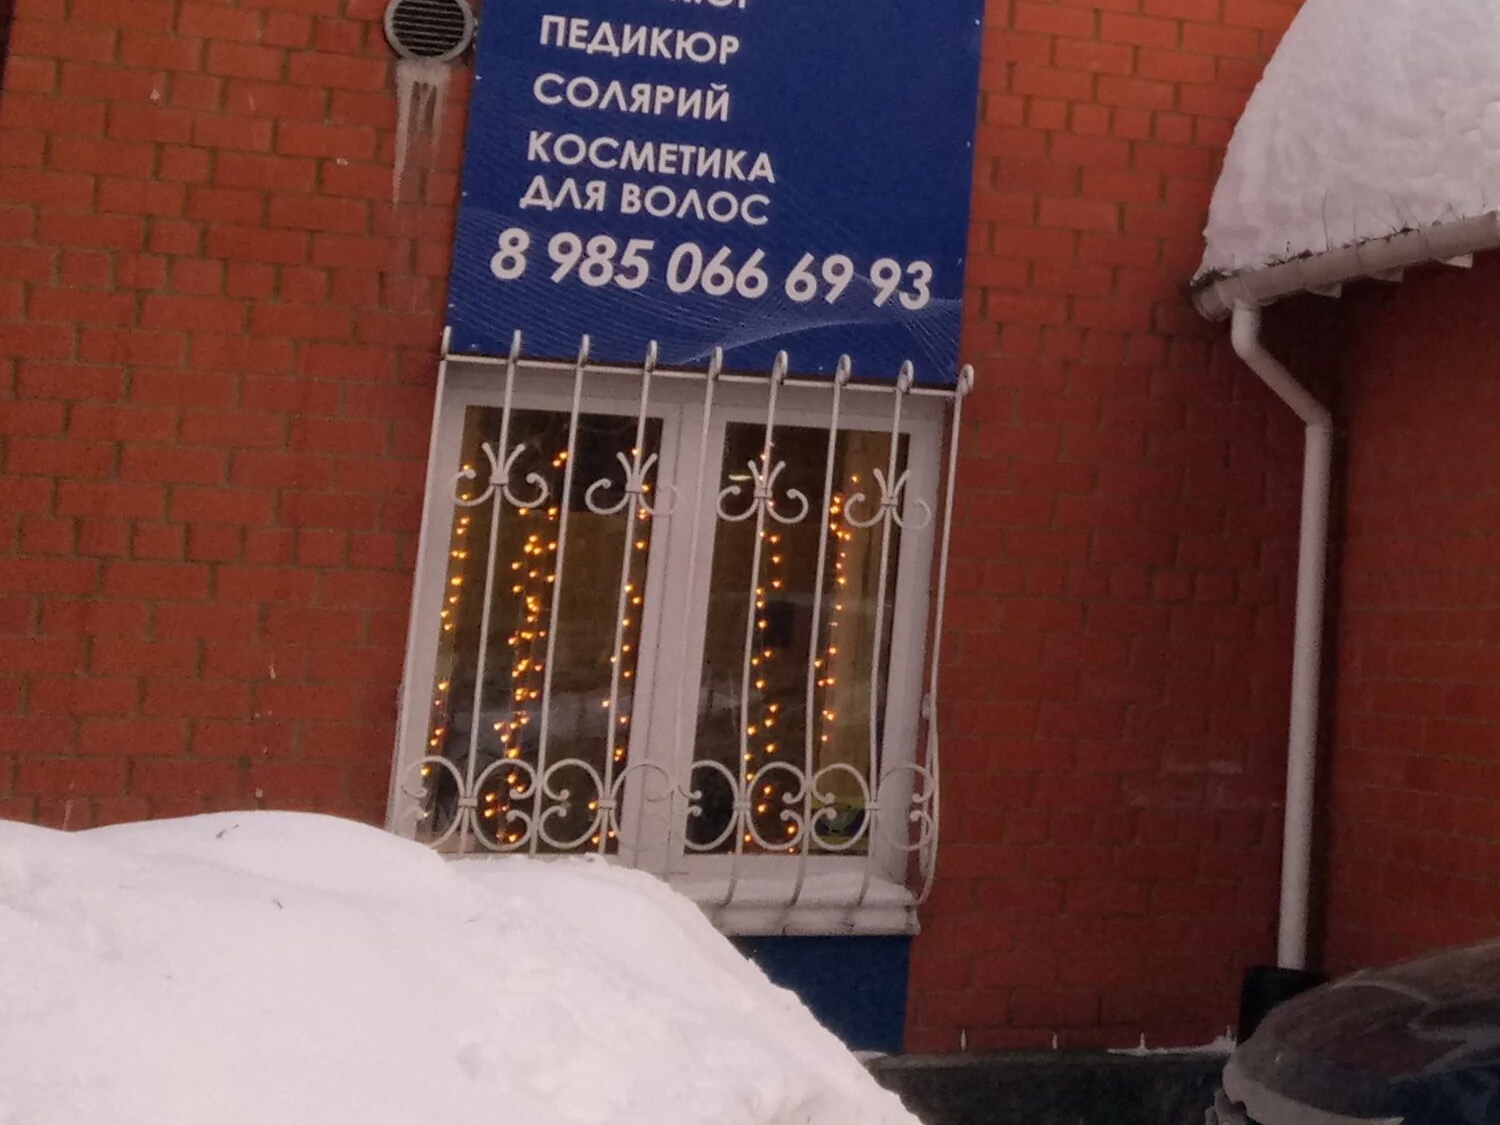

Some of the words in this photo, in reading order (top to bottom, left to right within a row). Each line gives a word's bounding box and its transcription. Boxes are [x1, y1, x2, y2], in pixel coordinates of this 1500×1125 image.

[539, 14, 740, 65] ПЕДИКЮР
[532, 72, 730, 122] СОЛЯРИЙ
[527, 130, 776, 184] КОСМЕТИКА
[519, 175, 607, 212] ДЛЯ
[620, 182, 771, 226] ВОЛОС
[490, 227, 531, 280] 8
[547, 231, 655, 290] 985
[666, 242, 769, 299] 066
[784, 252, 855, 305] 69
[869, 257, 933, 311] 93
